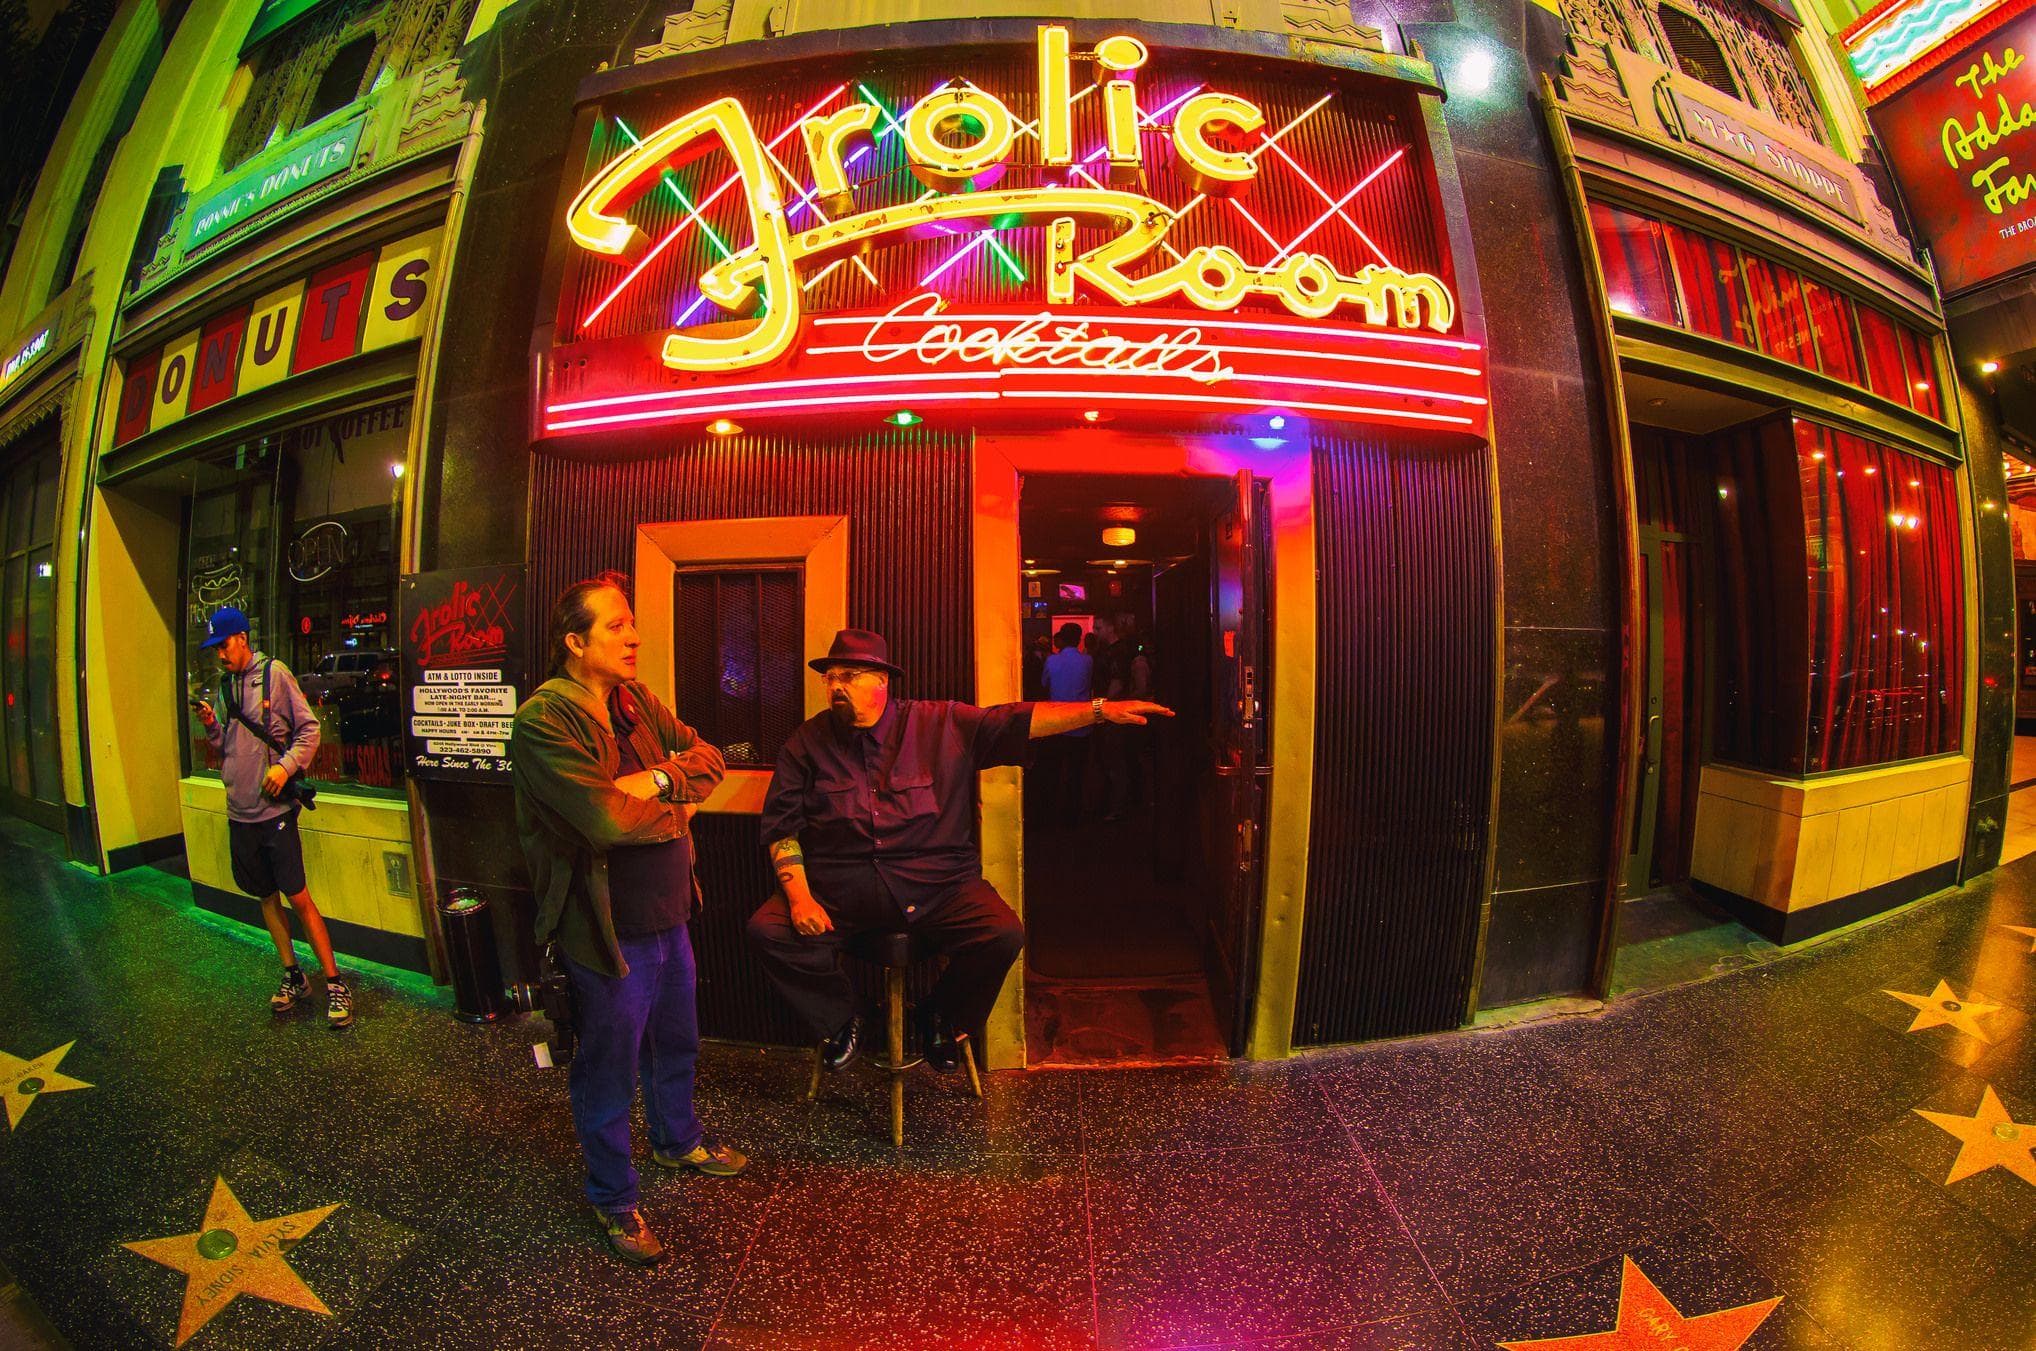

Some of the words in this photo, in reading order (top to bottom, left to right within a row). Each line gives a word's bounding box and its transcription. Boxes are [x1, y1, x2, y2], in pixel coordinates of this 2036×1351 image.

[1955, 47, 2025, 99] The
[568, 24, 1267, 372] Frolic
[1999, 224, 2017, 240] THE
[1046, 188, 1456, 335] Room
[124, 258, 431, 425] DONUTS
[863, 291, 1233, 383] Cocktails
[410, 581, 481, 666] Frolic
[448, 620, 504, 656] Room
[428, 672, 442, 680] ATM
[450, 672, 472, 680] LOTTO
[474, 672, 498, 680] INSIDE
[414, 720, 443, 728] COCKTAILS
[447, 720, 460, 728] JUKE
[416, 755, 439, 768] Here
[442, 756, 470, 768] Since
[472, 758, 492, 770] The
[249, 1220, 296, 1259] SYLVIA
[197, 1264, 244, 1306] SIDNEY
